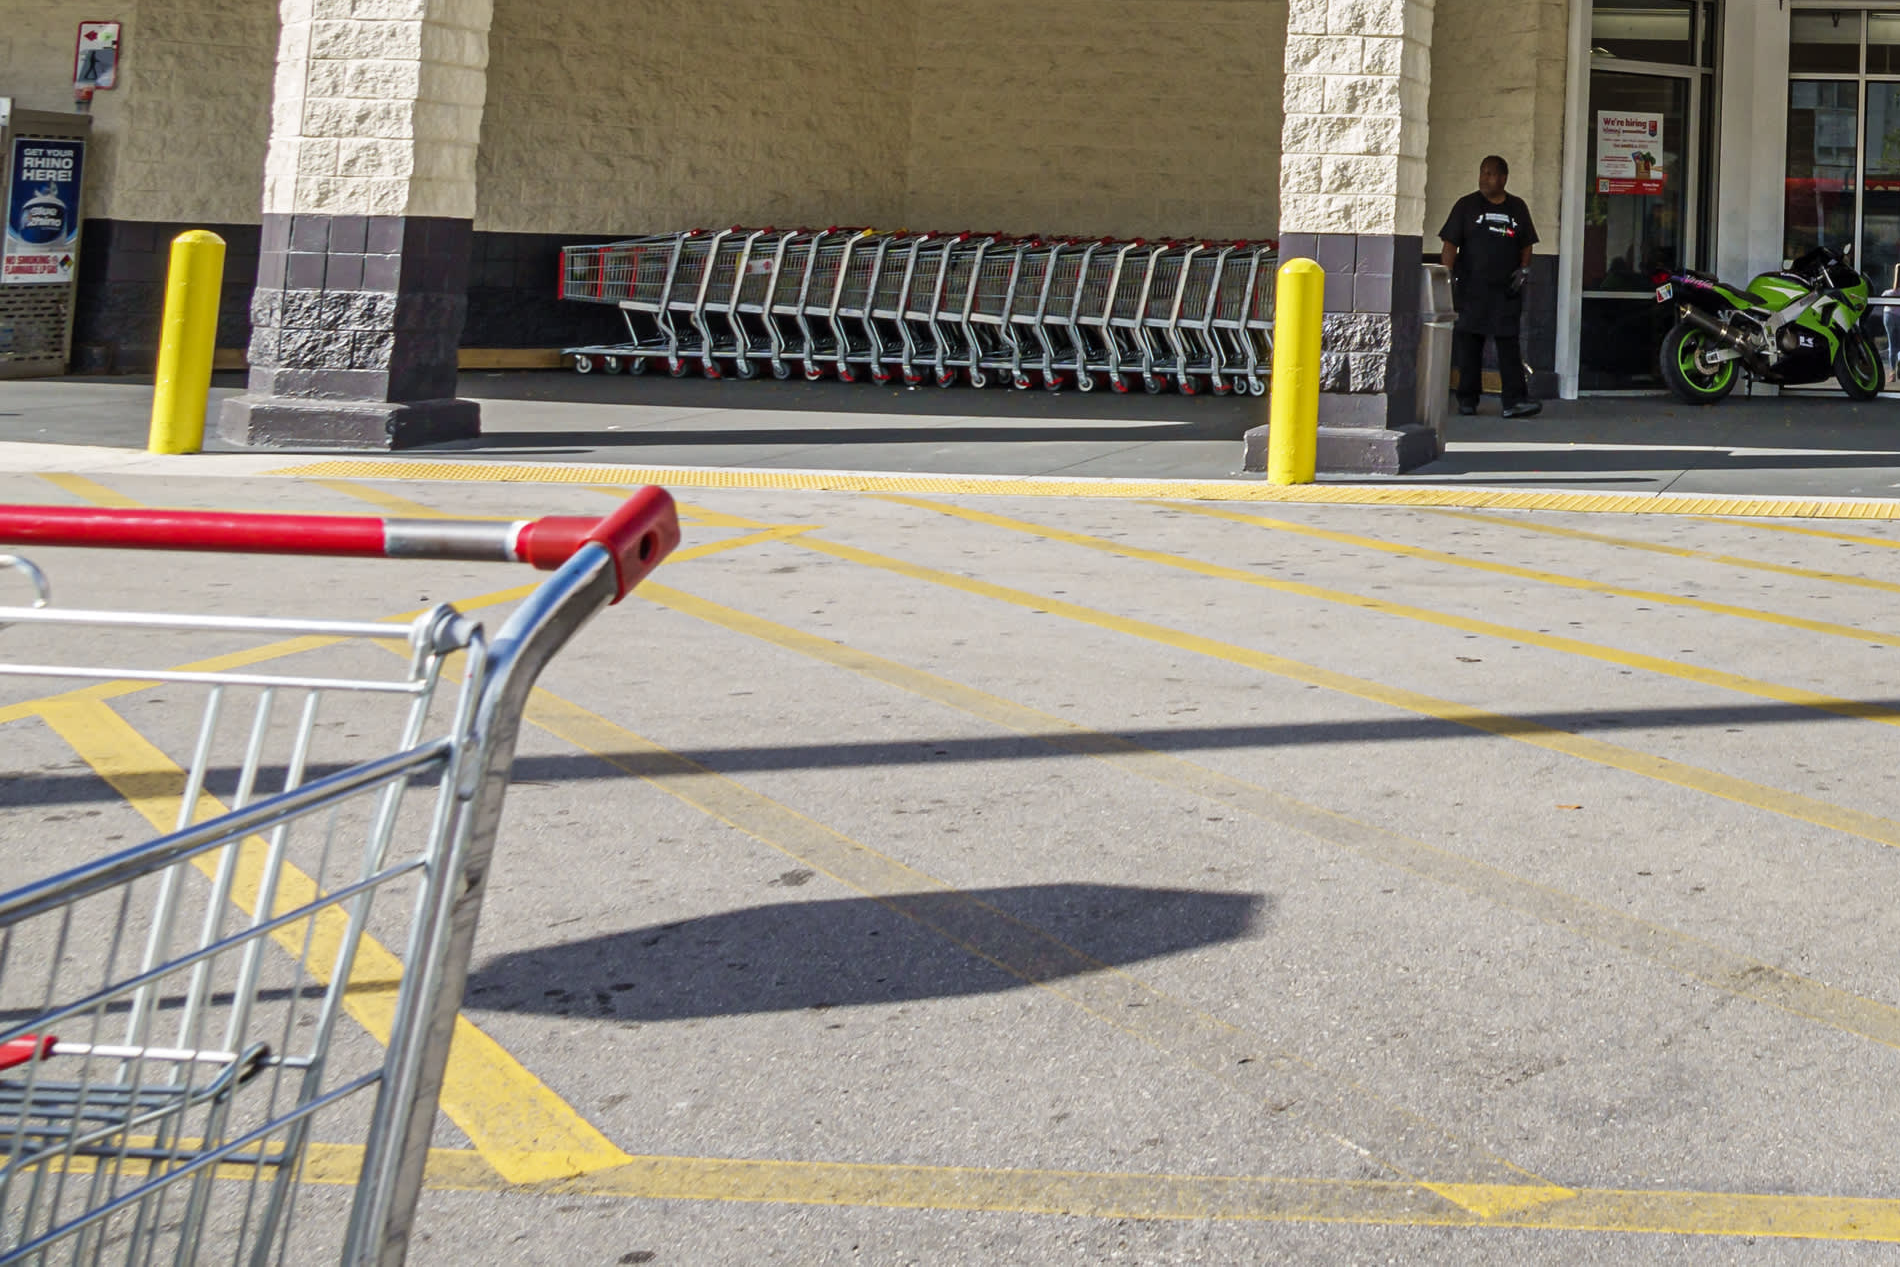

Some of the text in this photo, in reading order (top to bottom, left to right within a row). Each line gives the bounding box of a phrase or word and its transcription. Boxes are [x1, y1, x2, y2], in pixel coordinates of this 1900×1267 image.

[1625, 118, 1647, 130] hiring
[24, 148, 74, 157] GET YOUR
[23, 157, 74, 169] RHINO
[22, 169, 73, 182] HERE!
